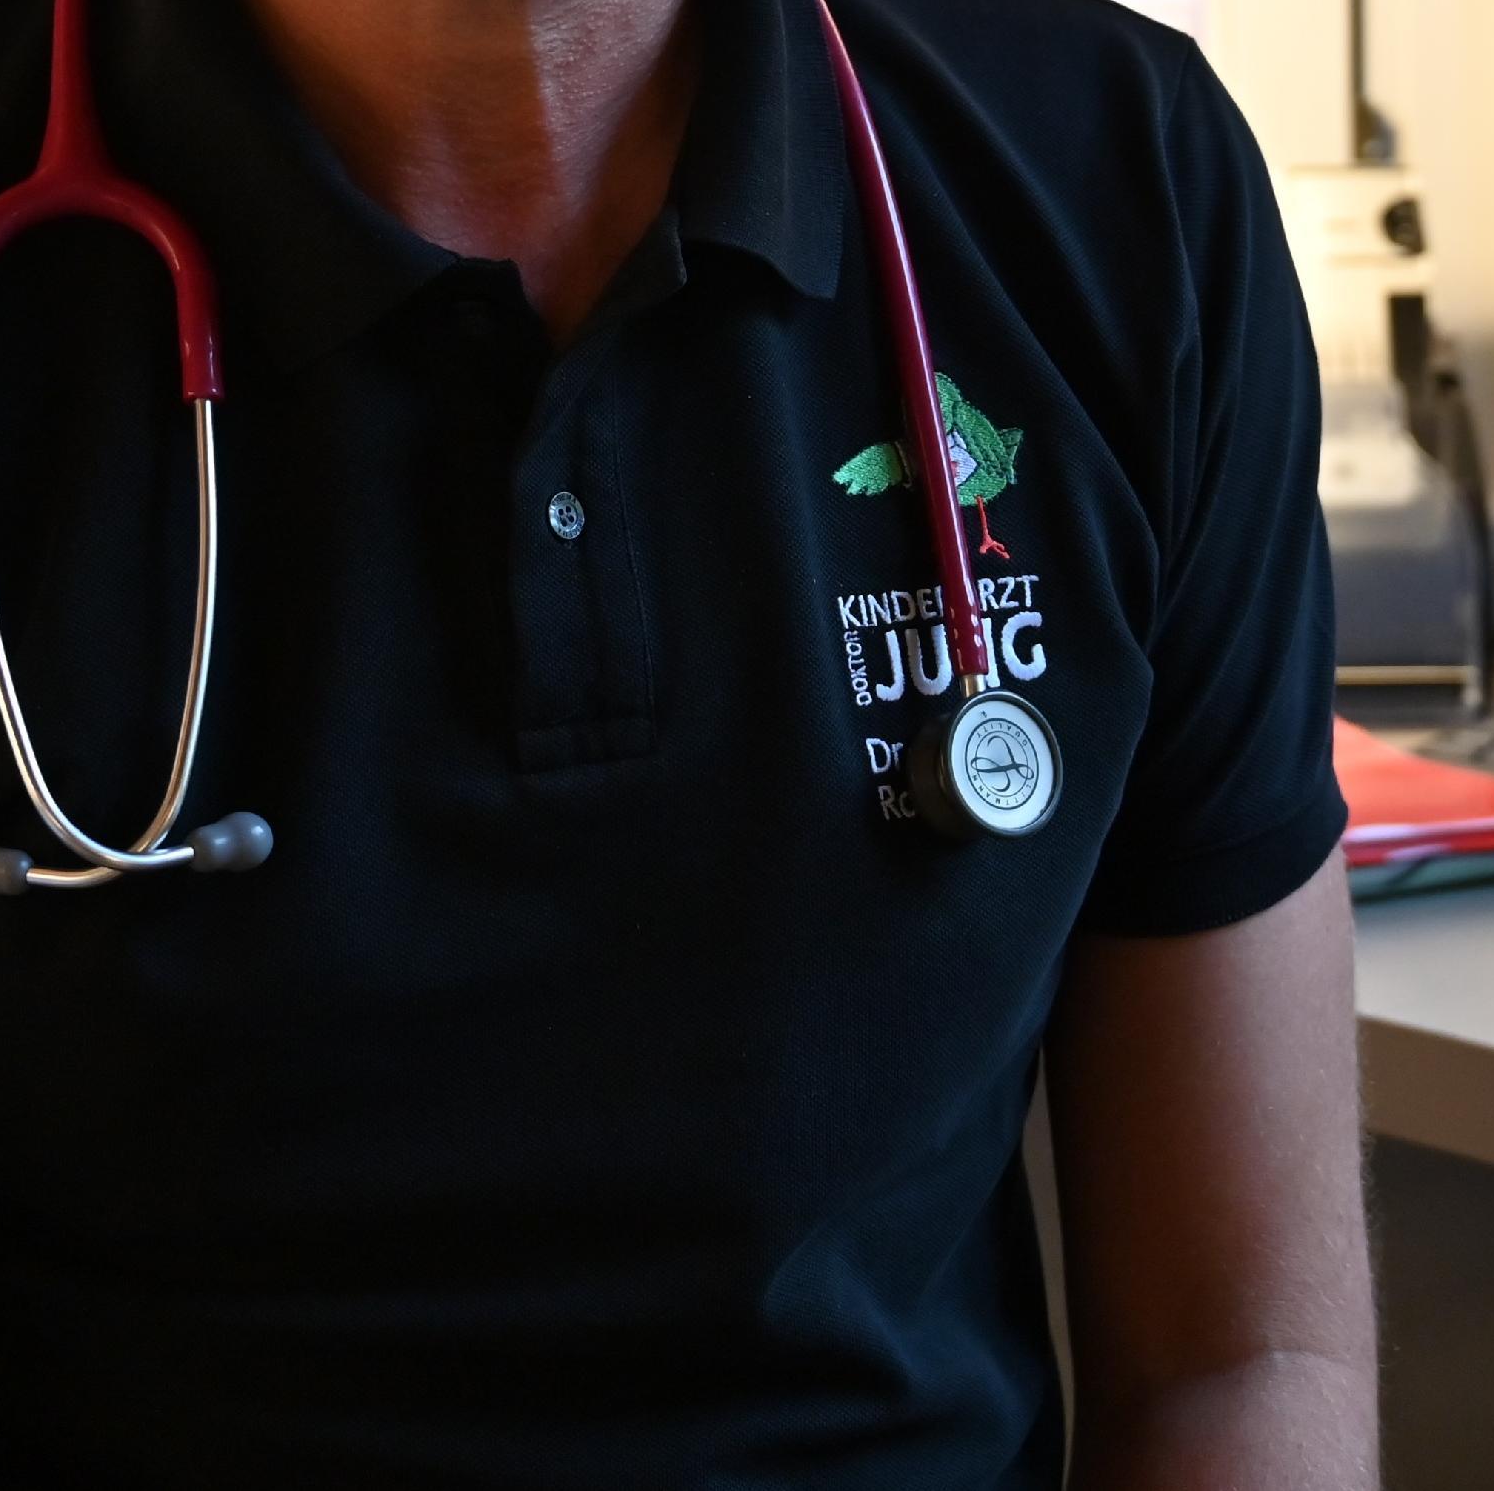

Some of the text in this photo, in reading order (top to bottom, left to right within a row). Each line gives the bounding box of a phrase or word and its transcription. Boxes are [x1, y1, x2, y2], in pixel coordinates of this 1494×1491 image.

[837, 574, 1040, 629] KINDERZT
[844, 629, 873, 707] DOKTOR
[976, 722, 1029, 748] QUALITY
[971, 774, 1032, 806] LITTMANN
